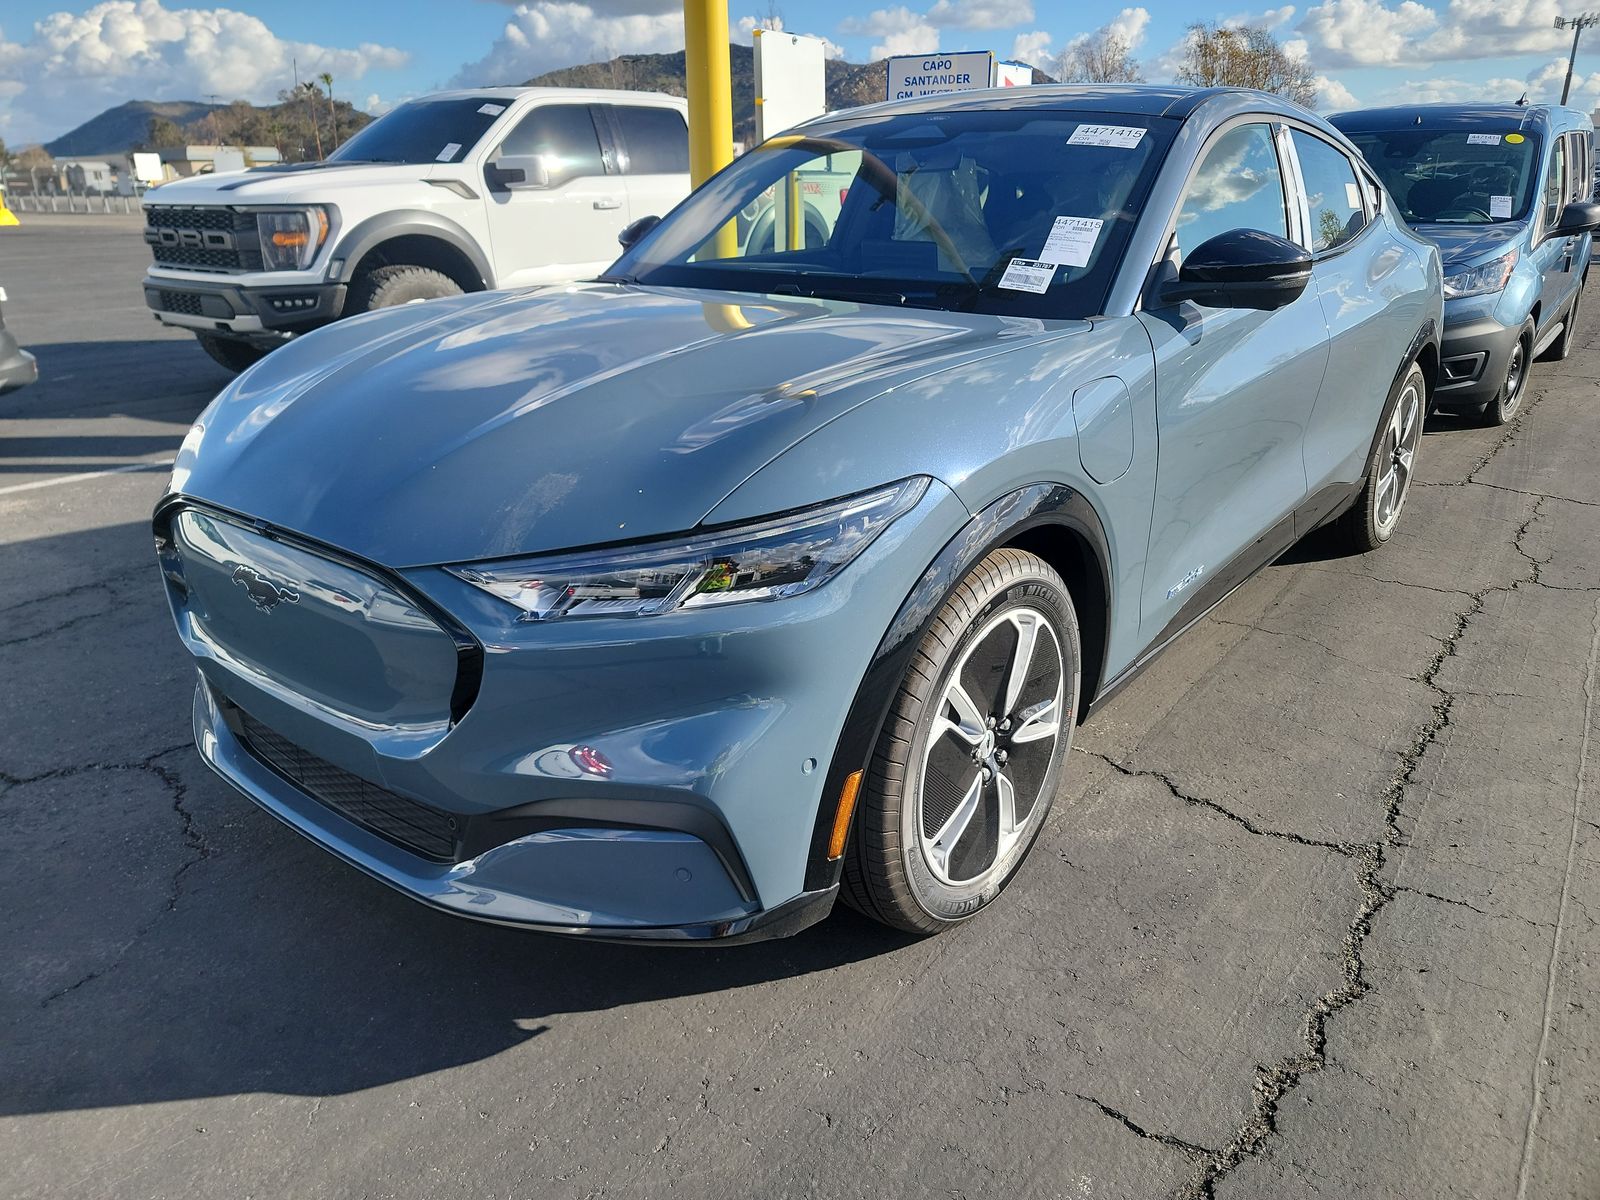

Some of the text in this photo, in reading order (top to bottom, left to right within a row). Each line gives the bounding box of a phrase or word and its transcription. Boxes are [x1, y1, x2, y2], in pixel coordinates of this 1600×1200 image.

[923, 60, 952, 71] CAPO
[904, 73, 970, 87] SANTANDER
[1081, 127, 1144, 138] 4471415
[1055, 219, 1102, 229] 4471415
